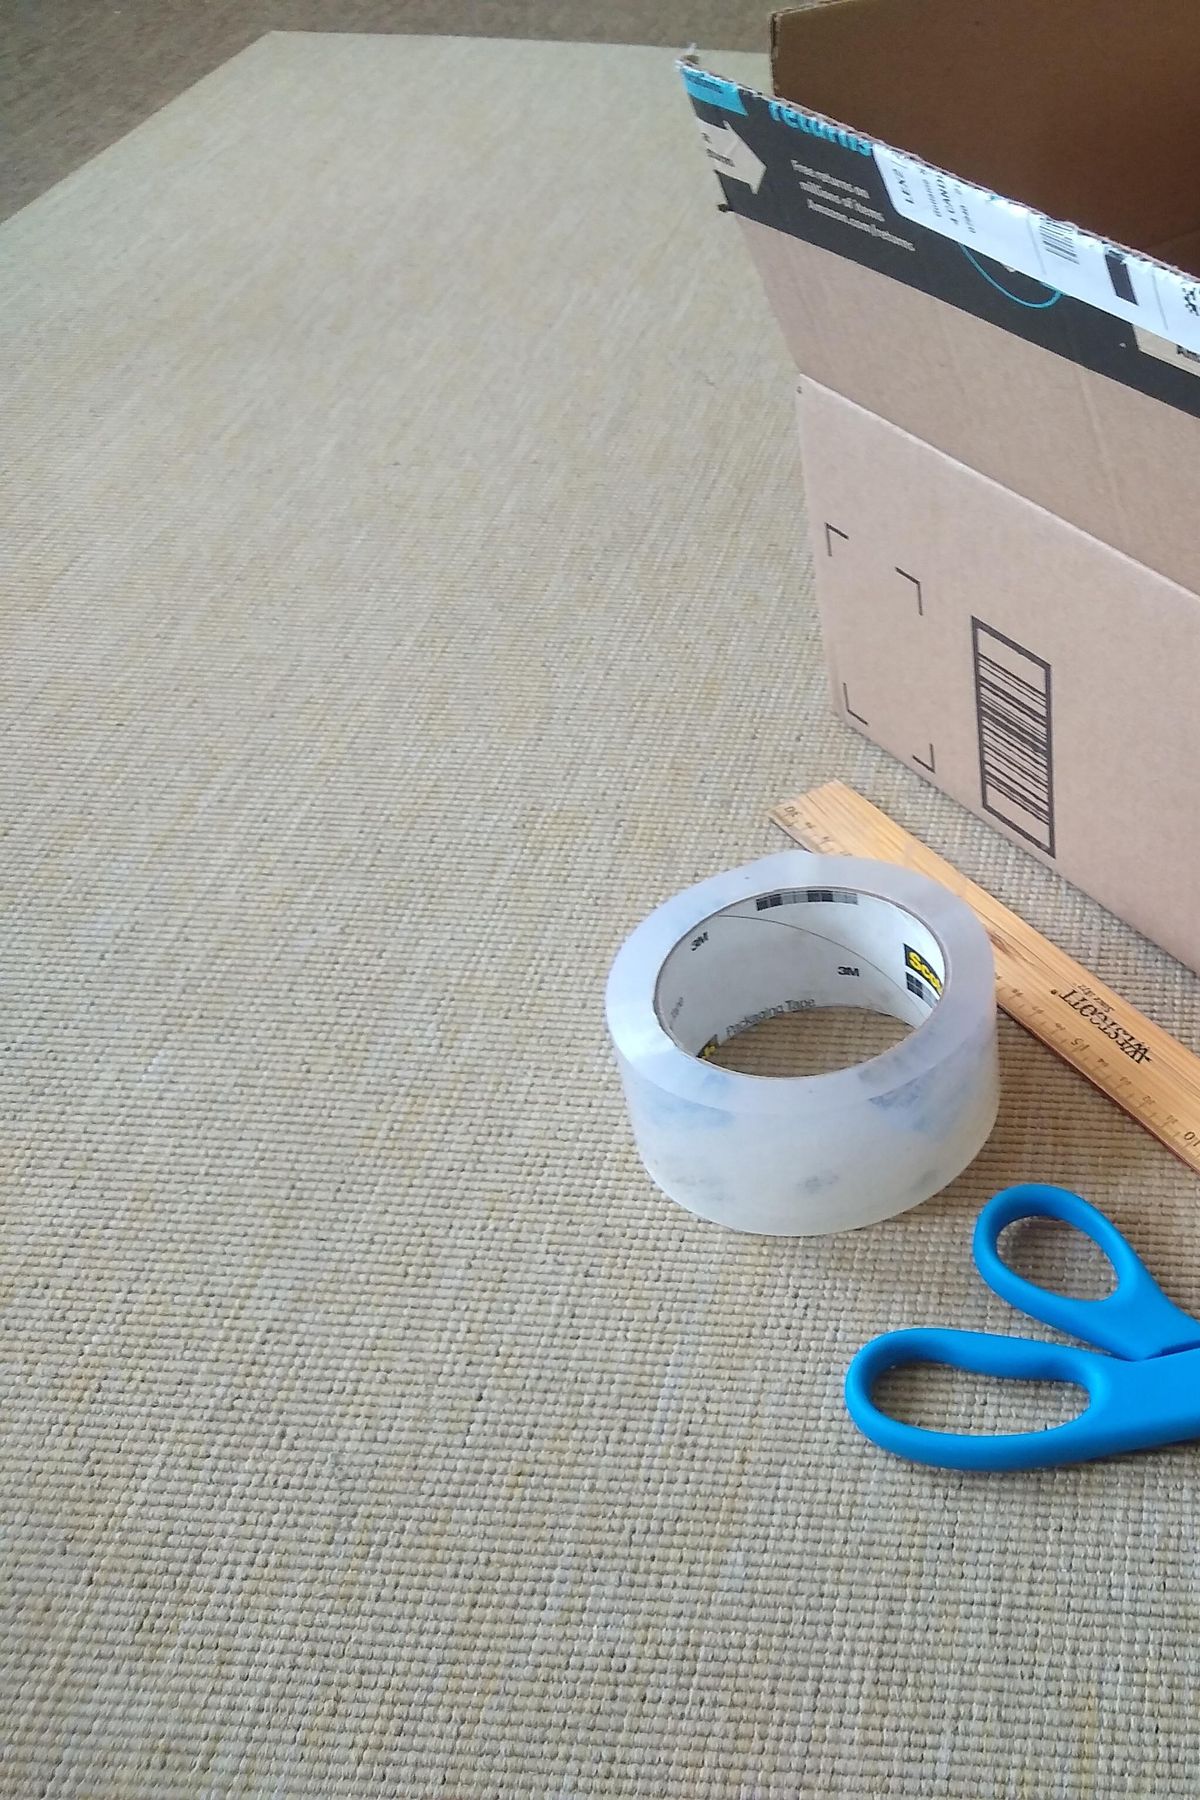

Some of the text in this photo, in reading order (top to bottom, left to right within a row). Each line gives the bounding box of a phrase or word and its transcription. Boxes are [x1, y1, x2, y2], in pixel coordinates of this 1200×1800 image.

[691, 931, 709, 951] 3M
[837, 966, 860, 977] 3M
[1057, 989, 1151, 1064] WESTCOTT
[1071, 1037, 1090, 1052] 15
